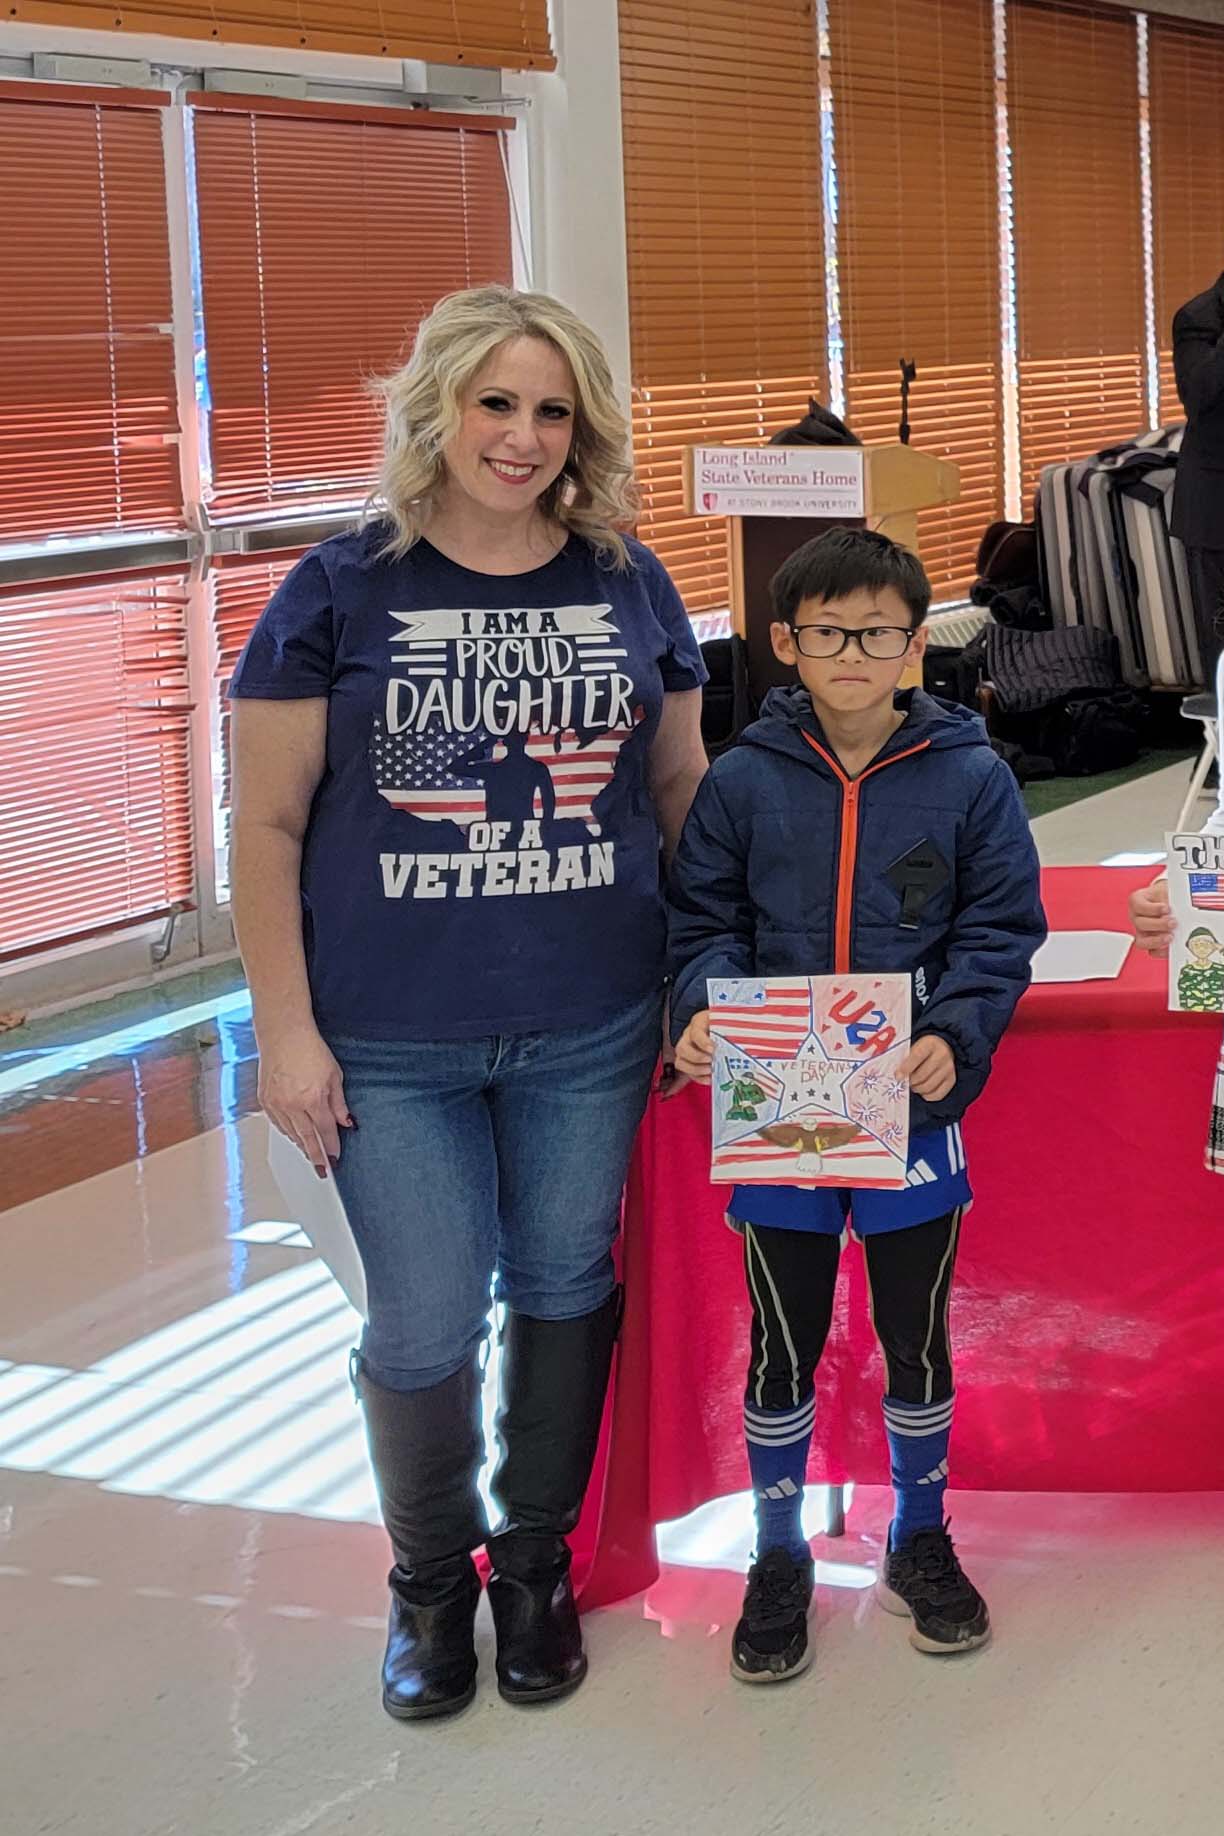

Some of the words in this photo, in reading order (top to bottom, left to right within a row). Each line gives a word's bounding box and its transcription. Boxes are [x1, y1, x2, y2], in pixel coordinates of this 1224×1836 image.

[702, 450, 738, 467] Long
[743, 451, 787, 466] Island
[701, 469, 740, 484] State
[744, 470, 808, 485] Veterans
[812, 471, 857, 486] Home
[461, 612, 471, 634] I
[482, 612, 529, 634] AM
[538, 612, 560, 633] A
[455, 638, 574, 678] PROUD
[385, 673, 634, 736] DAUGHTER
[468, 821, 512, 852] OF
[518, 820, 543, 848] A
[380, 841, 615, 898] VETERAN
[781, 1059, 852, 1074] VETERANS
[800, 1068, 827, 1085] DAY
